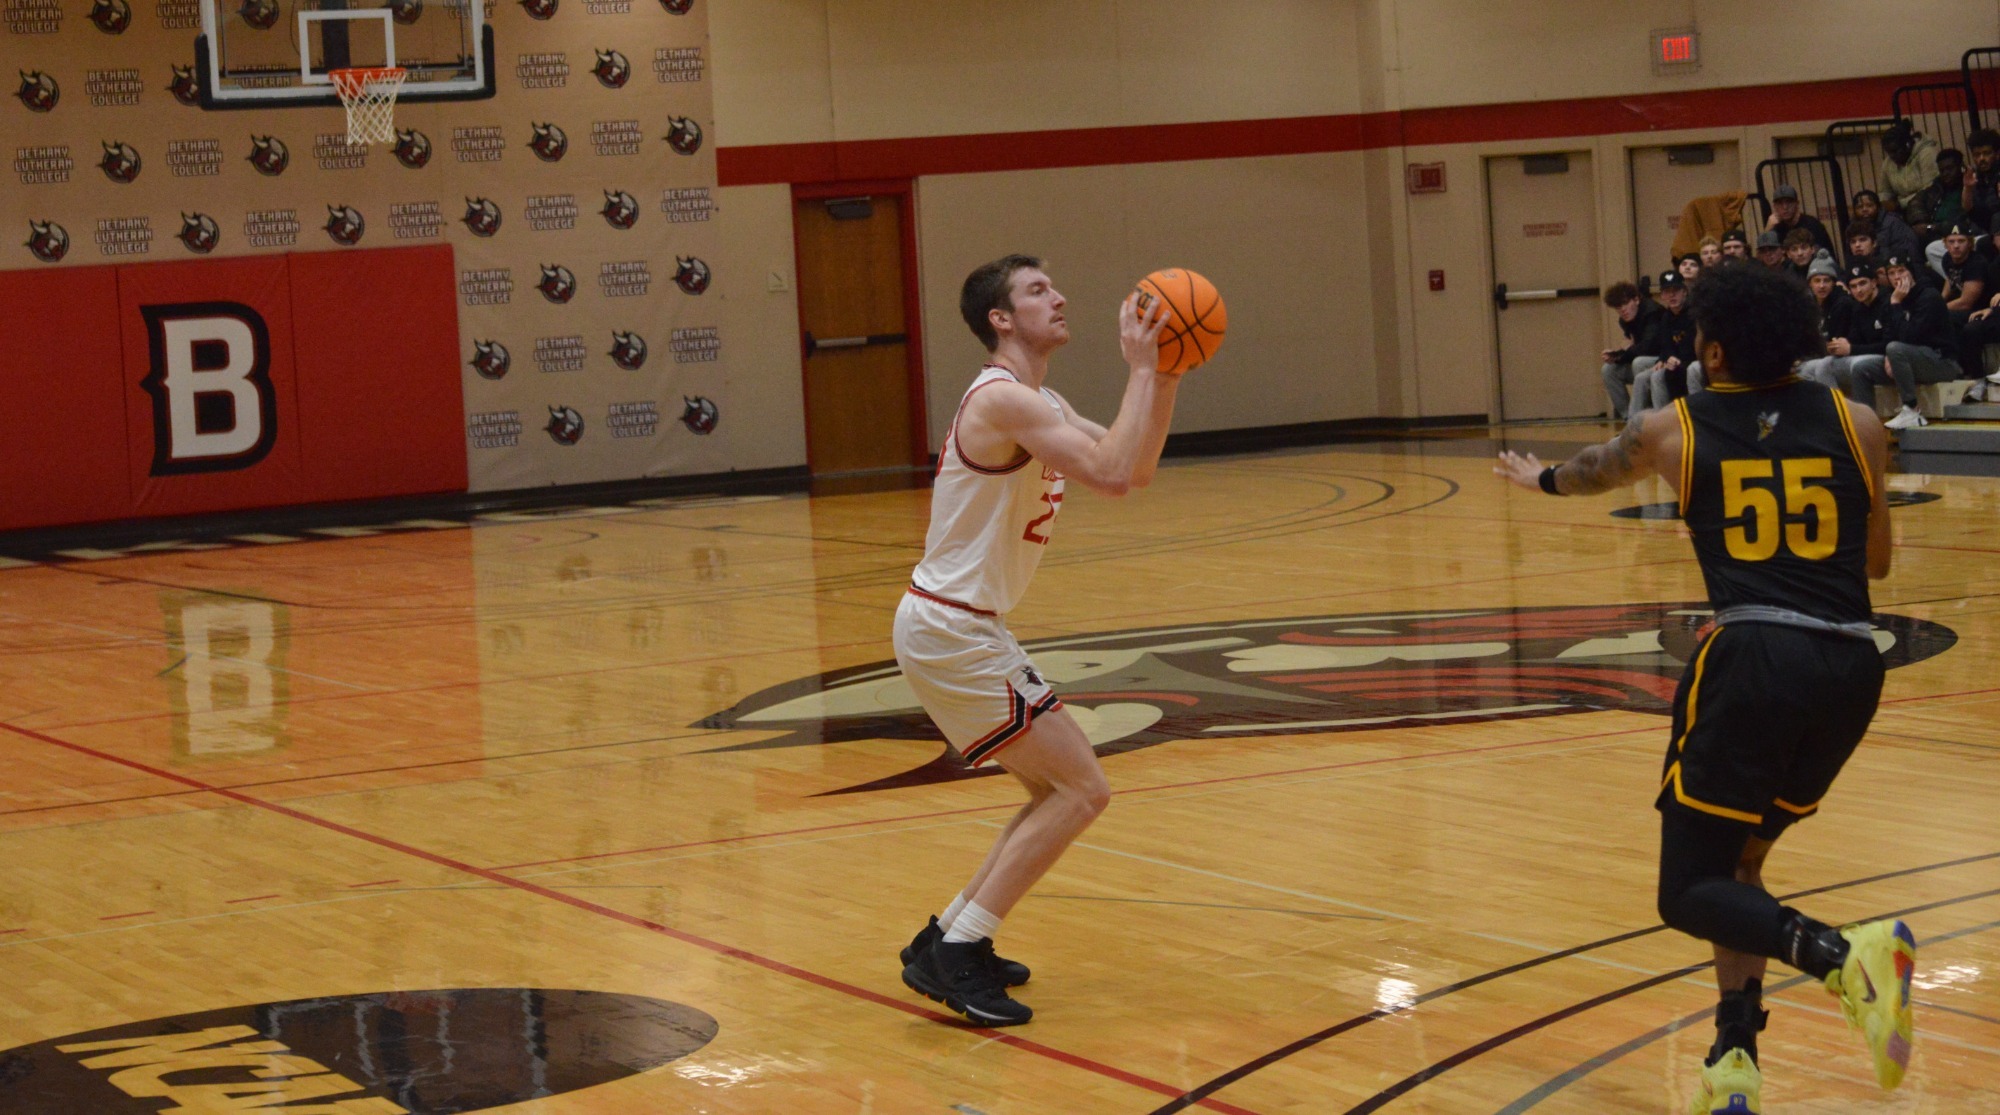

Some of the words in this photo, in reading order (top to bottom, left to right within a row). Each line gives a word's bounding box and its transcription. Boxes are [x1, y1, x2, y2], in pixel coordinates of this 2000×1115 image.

[157, 5, 201, 16] LUTHER
[587, 3, 630, 14] COLLEGE
[4, 9, 62, 21] LUTHERAN
[11, 22, 58, 34] COLLEGE
[163, 17, 202, 28] COLLEG
[656, 48, 700, 60] BETHANY
[1662, 36, 1690, 61] EXIT
[519, 54, 565, 65] BETHANY
[653, 60, 704, 71] LUTHERAN
[88, 70, 138, 81] BETHANY
[517, 65, 568, 76] LUTHERAN
[659, 71, 700, 82] COLLEGE
[85, 82, 143, 93] LUTHERAN
[522, 77, 565, 88] COLLEGE
[92, 94, 139, 105] COLLEGE
[593, 121, 638, 132] BETHANY
[454, 127, 501, 139] BETHANY
[591, 132, 642, 144] LUTHERAN
[169, 140, 218, 152] BETHANY
[452, 139, 504, 150] LUTHERAN
[596, 144, 638, 155] COLLEGE
[17, 147, 68, 159] BETHANY
[166, 152, 222, 164] LUTHERAN
[314, 146, 368, 158] LUTHERAN
[458, 150, 501, 162] COLLEGE
[15, 159, 72, 171] LUTHERAN
[320, 157, 364, 168] COLLEGE
[173, 164, 219, 176] COLLEGE
[21, 171, 69, 183] COLLEGE
[664, 188, 708, 200] BETHANY
[528, 195, 574, 207] BETHANY
[661, 199, 712, 211] LUTHERAN
[391, 203, 438, 215] BETHANY
[525, 206, 577, 219] LUTHERAN
[248, 211, 295, 223] BETHANY
[388, 214, 442, 226] LUTHERAN
[667, 211, 708, 222] COLLEGE
[98, 218, 148, 231] BETHANY
[245, 222, 299, 234] LUTHERAN
[531, 218, 574, 230] COLLEGE
[95, 230, 152, 242] LUTHERAN
[394, 226, 438, 237] COLLEGE
[251, 234, 295, 245] COLLEGE
[101, 242, 148, 254] COLLEGE
[602, 261, 646, 274] BETHANY
[464, 270, 509, 282] BETHANY
[599, 273, 650, 285] LUTHERAN
[462, 281, 512, 293] LUTHERAN
[604, 284, 646, 296] COLLEGE
[467, 293, 509, 304] COLLEGE
[672, 328, 716, 340] BETHANY
[536, 337, 582, 349] BETHANY
[670, 339, 720, 351] LUTHERAN
[534, 348, 586, 361] LUTHERAN
[675, 350, 716, 362] COLLEGE
[539, 360, 582, 372] COLLEGE
[158, 313, 266, 463] B
[610, 402, 654, 415] BETHANY
[471, 412, 518, 424] BETHANY
[607, 413, 658, 426] LUTHERAN
[468, 423, 522, 437] LUTHERAN
[612, 425, 654, 437] COLLEGE
[472, 436, 518, 448] COLLEGE
[1721, 457, 1839, 562] 55
